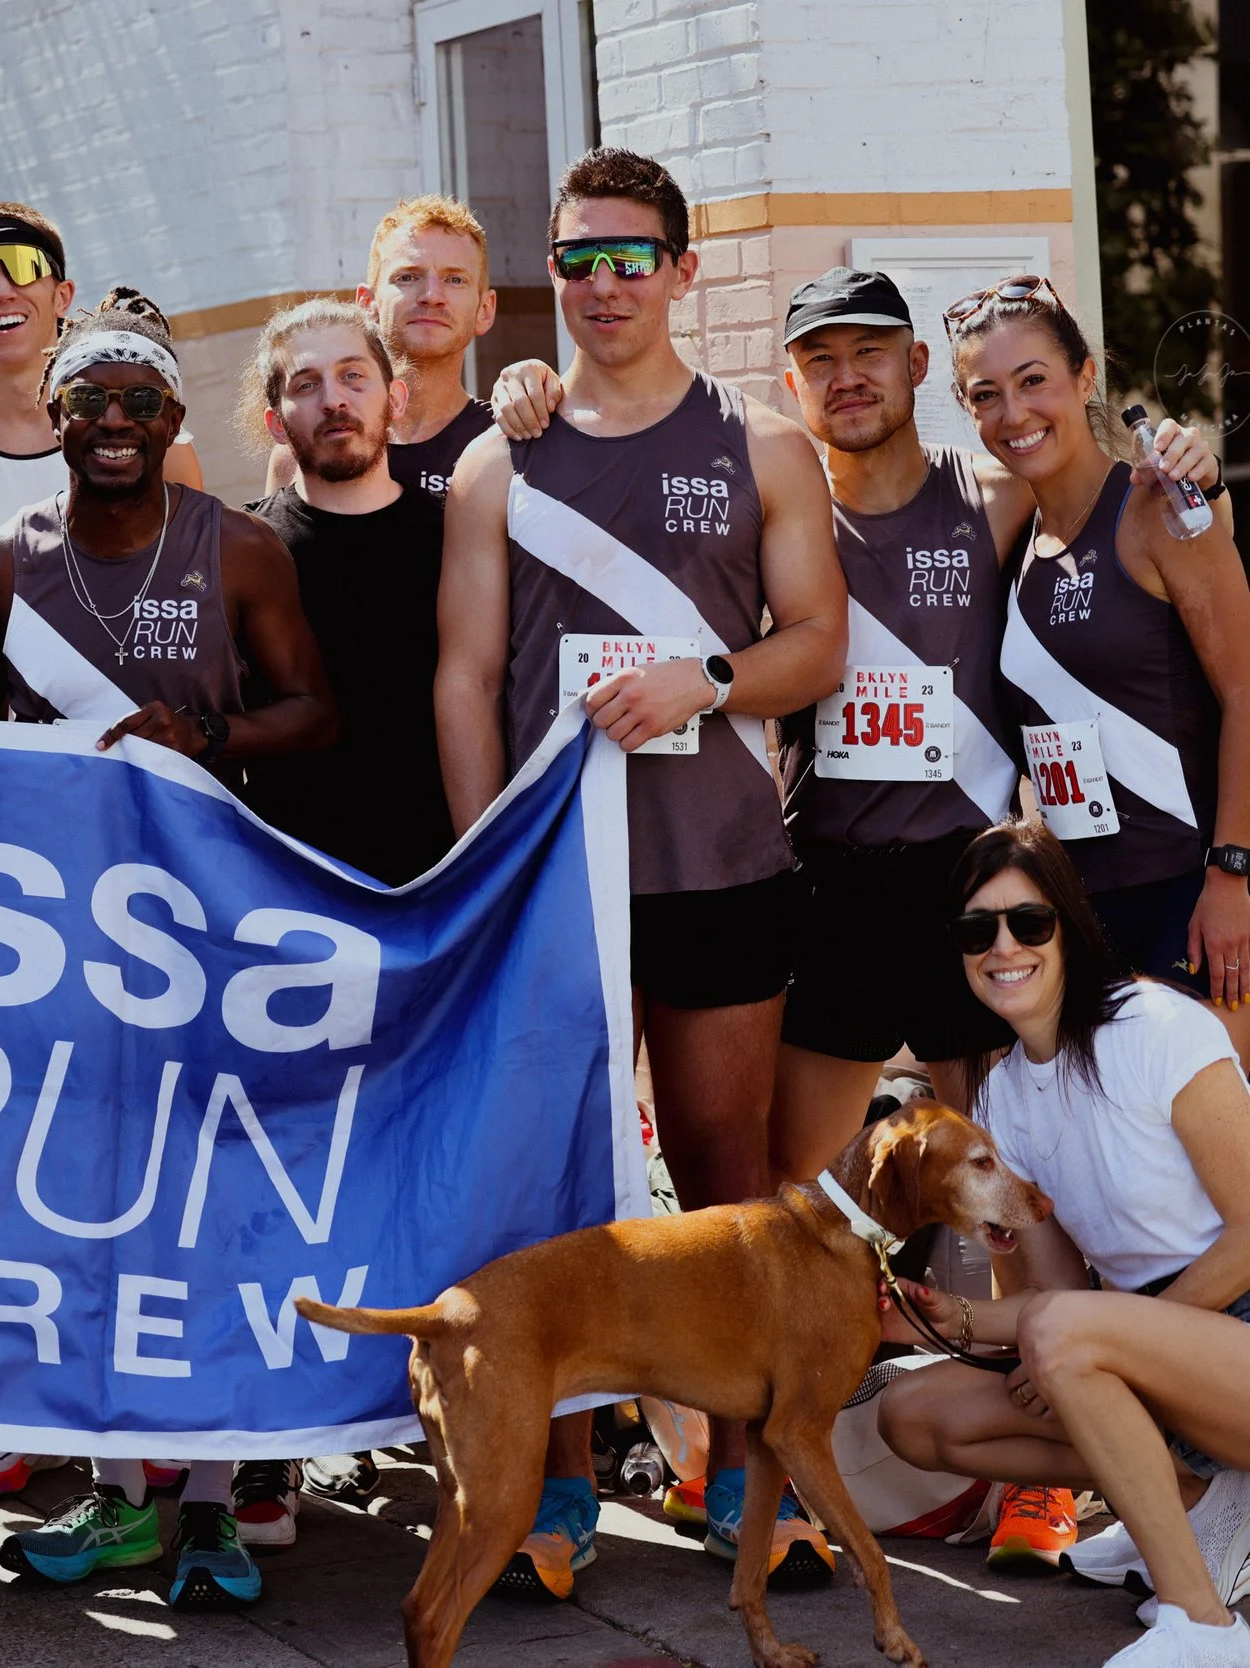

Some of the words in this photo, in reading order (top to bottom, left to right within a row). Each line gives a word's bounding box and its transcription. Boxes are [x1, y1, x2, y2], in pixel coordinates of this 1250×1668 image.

[1179, 318, 1236, 337] PLANTAS
[420, 471, 454, 491] is
[662, 473, 729, 498] issa
[665, 496, 729, 520] RUN
[665, 520, 730, 536] CREW
[906, 547, 969, 569] issa
[909, 570, 970, 592] RUN
[1054, 572, 1094, 595] issa
[134, 595, 198, 619] issa
[910, 594, 971, 607] CREW
[1051, 589, 1092, 614] RUN
[1050, 609, 1091, 626] CREW
[134, 621, 198, 644] RUN
[133, 646, 197, 660] CREW
[602, 641, 656, 653] BKLYN
[578, 652, 589, 663] 20
[856, 671, 908, 683] BKLYN
[856, 685, 908, 698] MILE
[921, 685, 934, 695] 23
[842, 702, 924, 747] 1345
[1029, 731, 1060, 744] BKLYN
[672, 742, 688, 751] 1531
[827, 750, 849, 759] HOKA
[1032, 745, 1063, 758] MILE
[1071, 740, 1082, 751] 23
[924, 769, 942, 778] 1345
[1033, 760, 1086, 806] 1201
[1094, 823, 1109, 833] 1201
